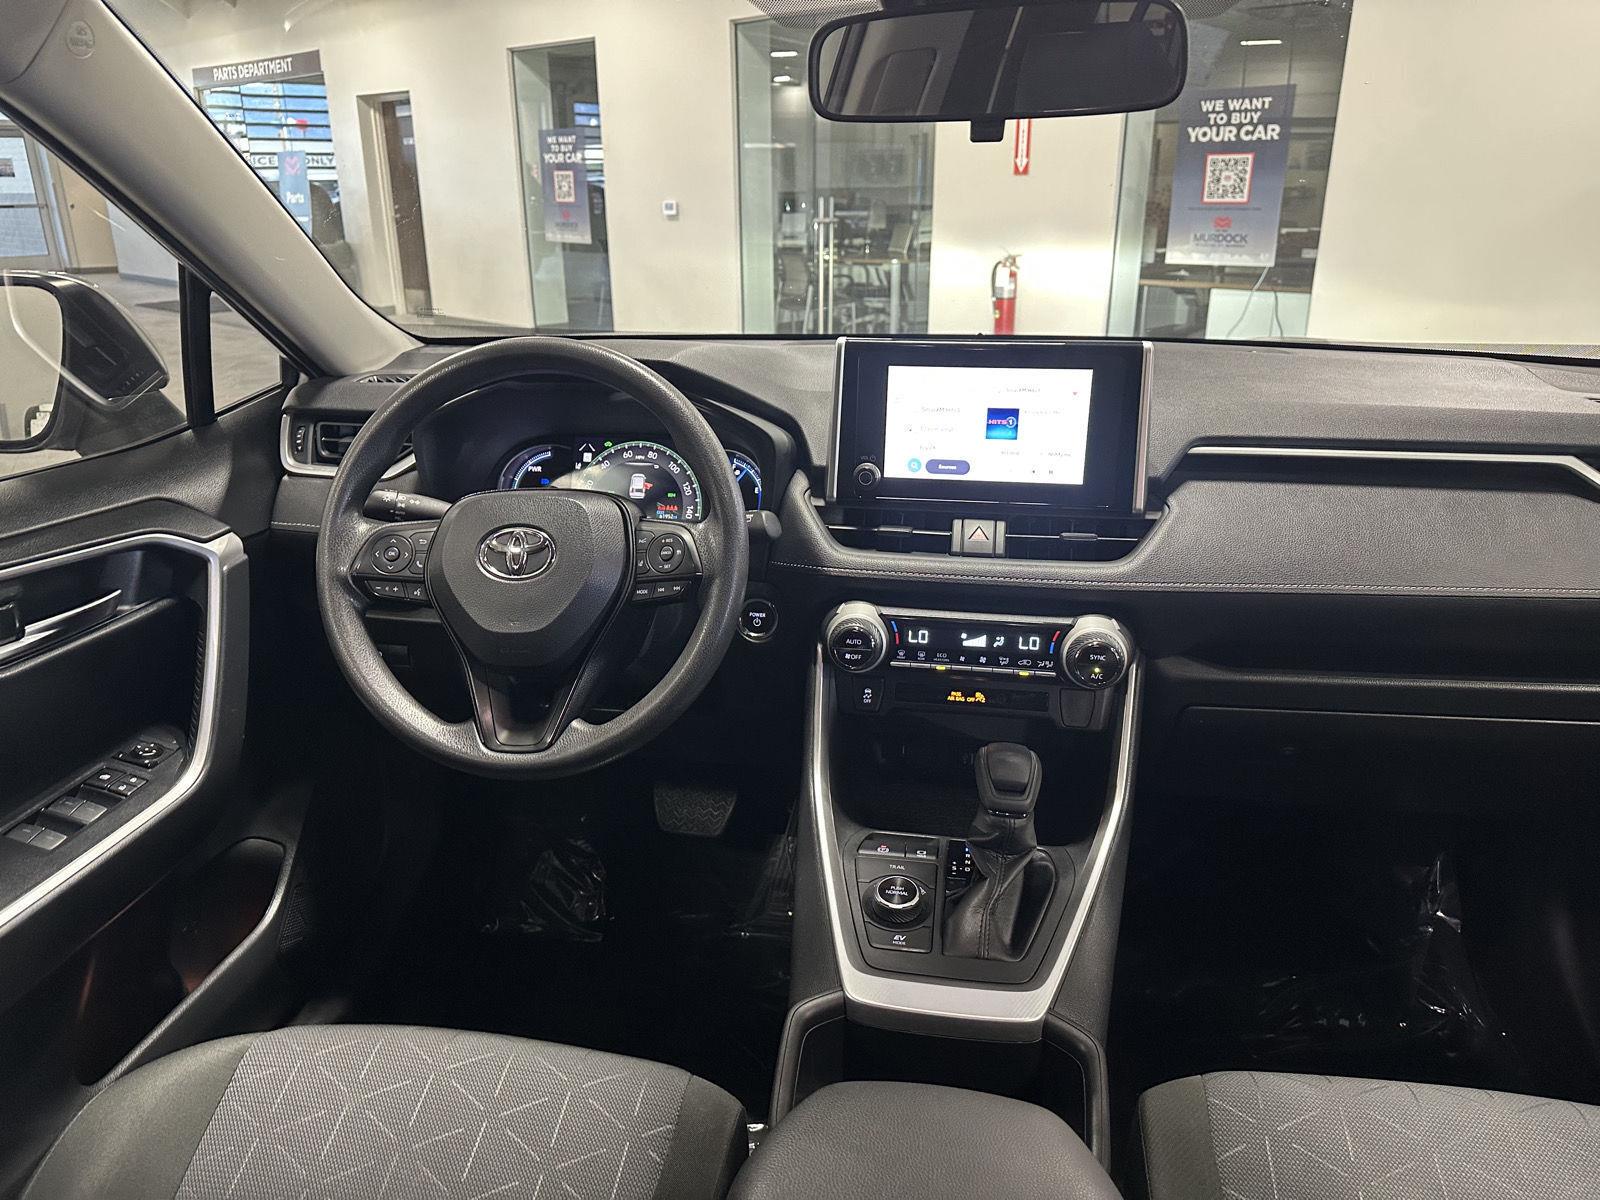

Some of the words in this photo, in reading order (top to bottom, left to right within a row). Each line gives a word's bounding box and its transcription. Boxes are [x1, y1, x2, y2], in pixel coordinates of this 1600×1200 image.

[213, 65, 238, 81] PARTS
[238, 57, 293, 79] DEPARTMENT
[1201, 99, 1224, 112] WE
[1228, 96, 1272, 111] WANT
[1208, 113, 1228, 125] TO
[1230, 111, 1261, 124] BUY
[1187, 126, 1238, 142] YOUR
[1239, 124, 1280, 141] CAR
[543, 153, 565, 163] YOUR
[1193, 233, 1248, 244] MURDOCK
[623, 450, 633, 459] 60
[647, 451, 658, 460] 80
[668, 461, 681, 475] 100
[683, 481, 693, 497] 120
[685, 505, 694, 520] 140
[1089, 653, 1107, 661] SYNC
